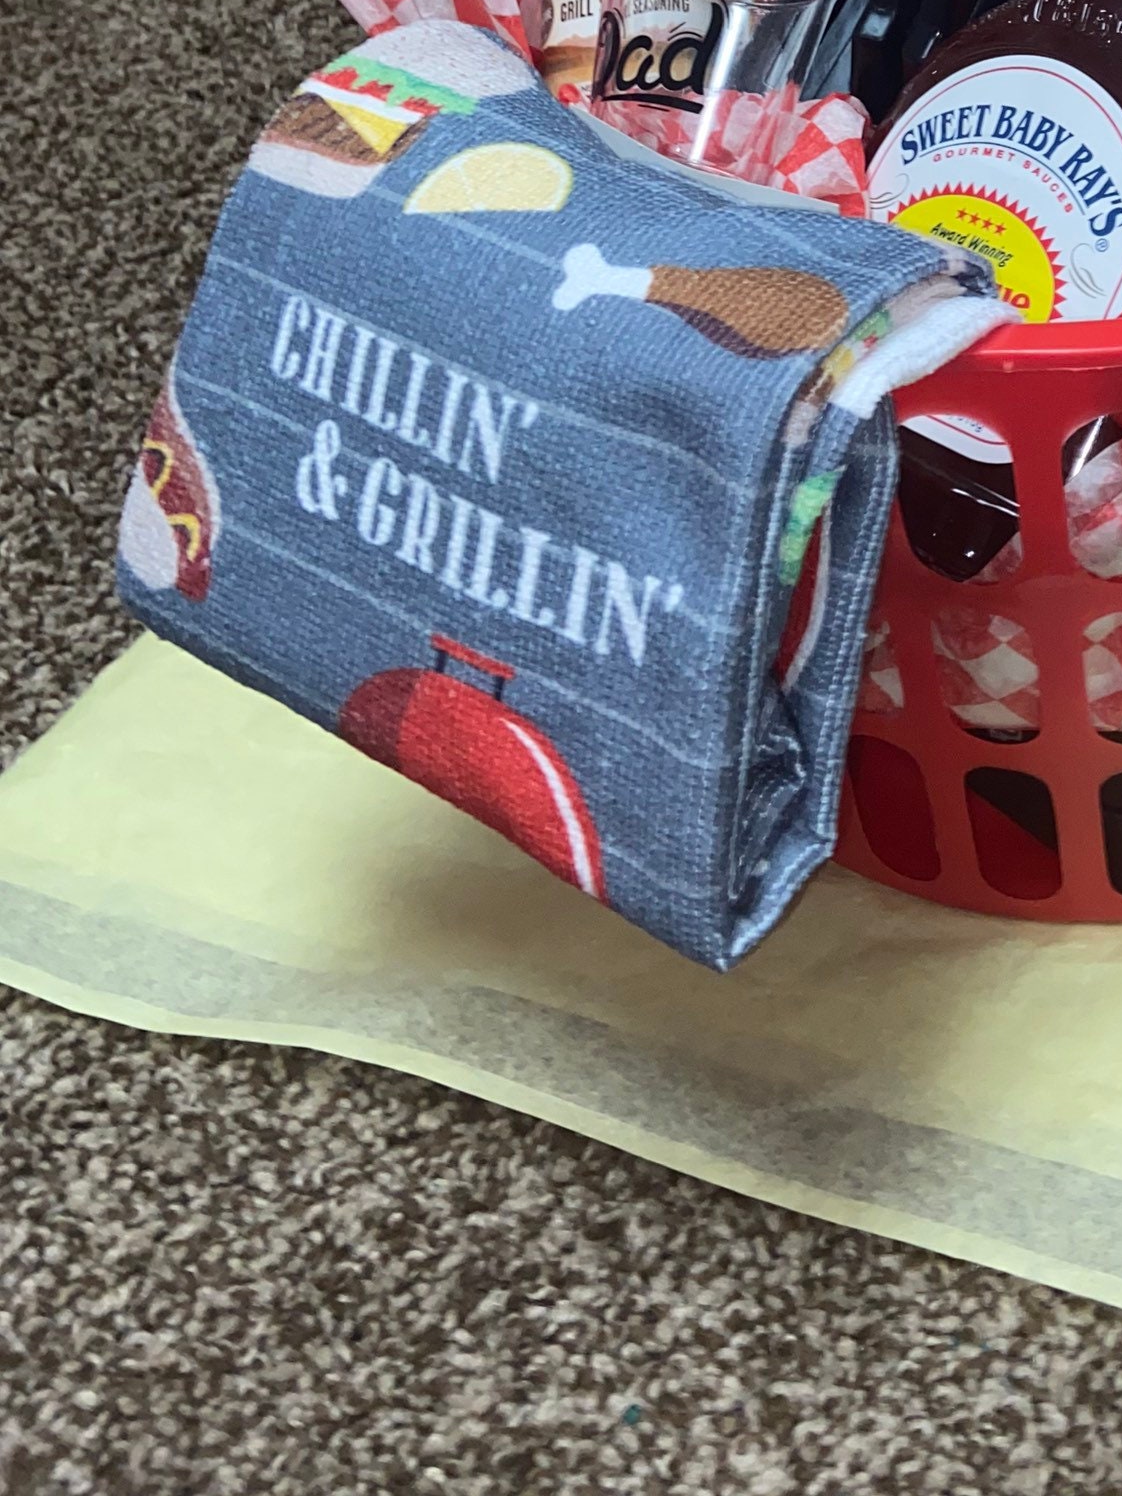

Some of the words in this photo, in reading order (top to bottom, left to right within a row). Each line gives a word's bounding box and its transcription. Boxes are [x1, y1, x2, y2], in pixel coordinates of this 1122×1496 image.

[900, 105, 991, 165] SWEET
[991, 105, 1074, 157] BABY
[932, 145, 1015, 162] GOURMET
[1023, 160, 1073, 213] SAUCES
[929, 222, 968, 245] Award
[968, 236, 1014, 268] Winning
[271, 294, 540, 485] CHILLIN'
[296, 418, 350, 522] &
[356, 455, 686, 668] GRILLIN'
